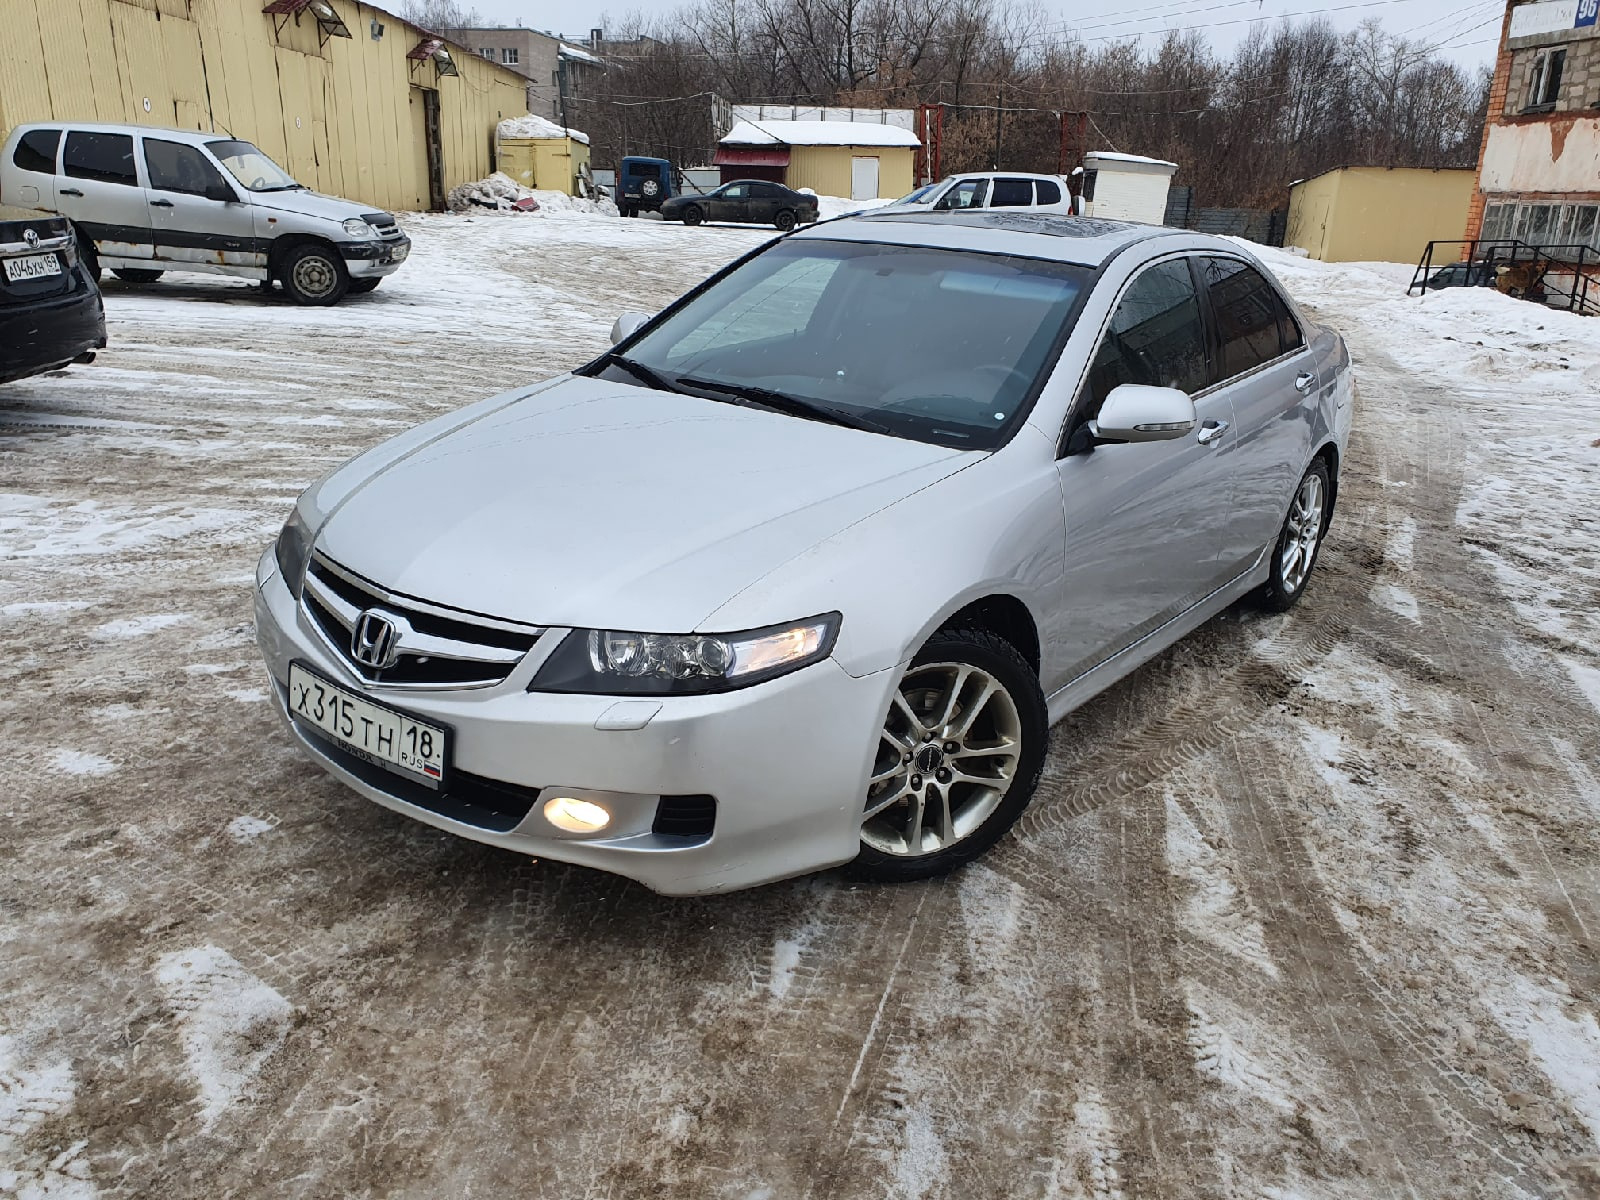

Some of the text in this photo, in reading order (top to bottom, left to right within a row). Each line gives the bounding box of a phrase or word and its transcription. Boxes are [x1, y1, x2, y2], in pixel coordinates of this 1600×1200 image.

[1578, 0, 1597, 20] 96
[407, 725, 433, 759] 18
[401, 751, 423, 769] RUS
